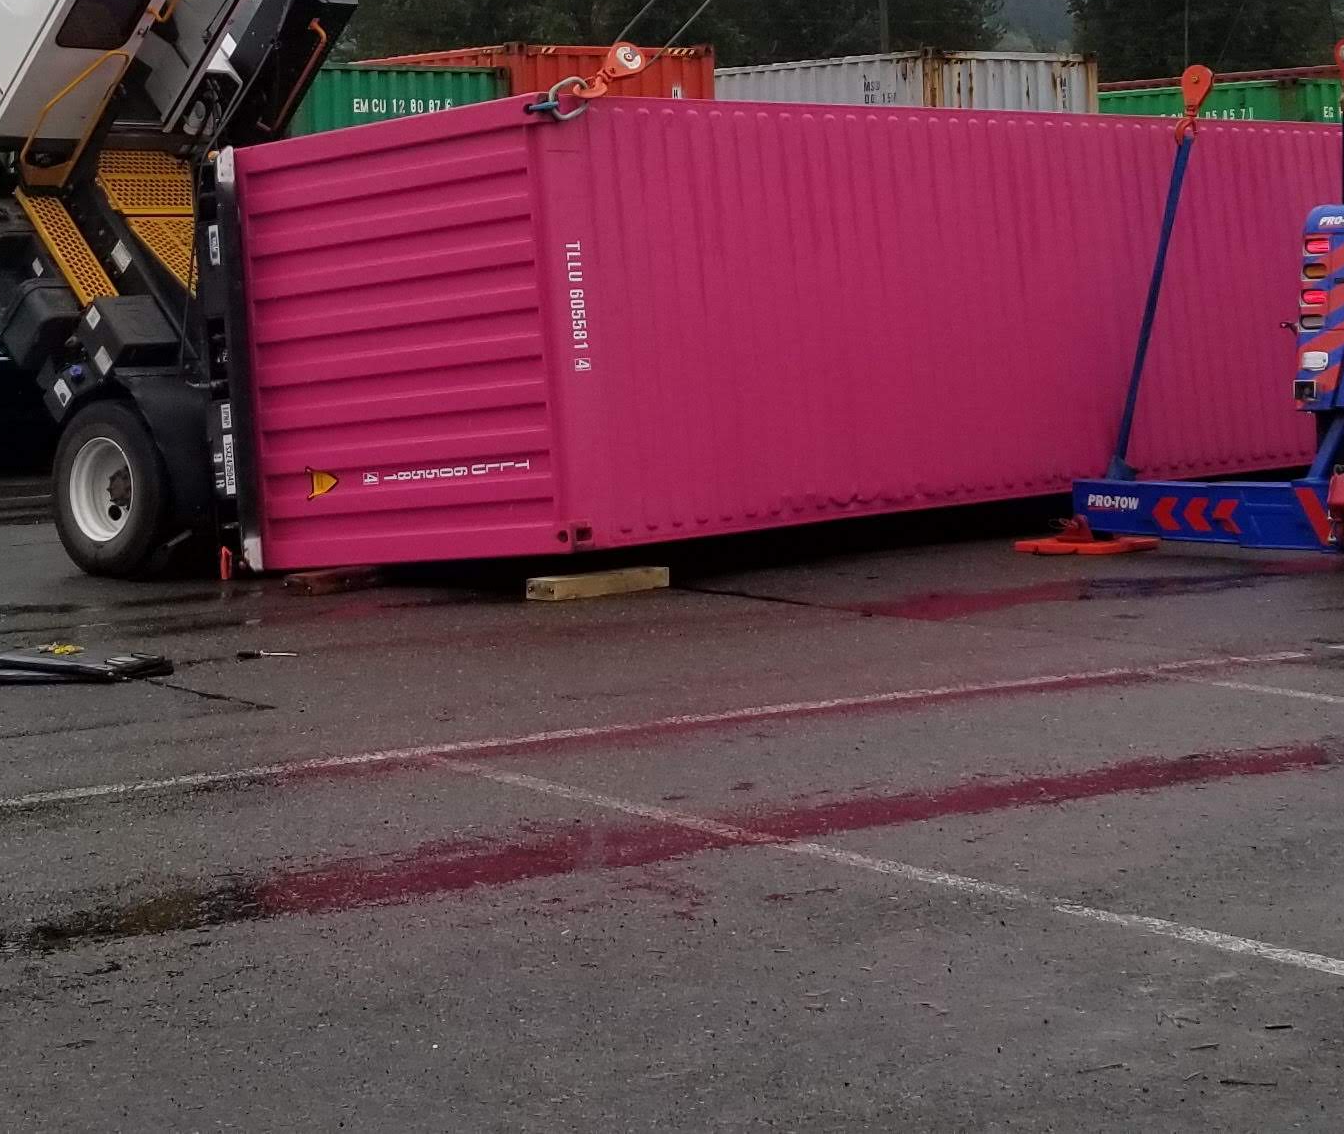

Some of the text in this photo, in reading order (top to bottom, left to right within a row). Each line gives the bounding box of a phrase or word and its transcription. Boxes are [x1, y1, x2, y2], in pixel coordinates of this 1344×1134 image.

[565, 240, 591, 371] TLLU 605581 4
[384, 466, 469, 481] 605581
[471, 459, 530, 475] TLLU
[1087, 494, 1140, 511] PRO-TOW
